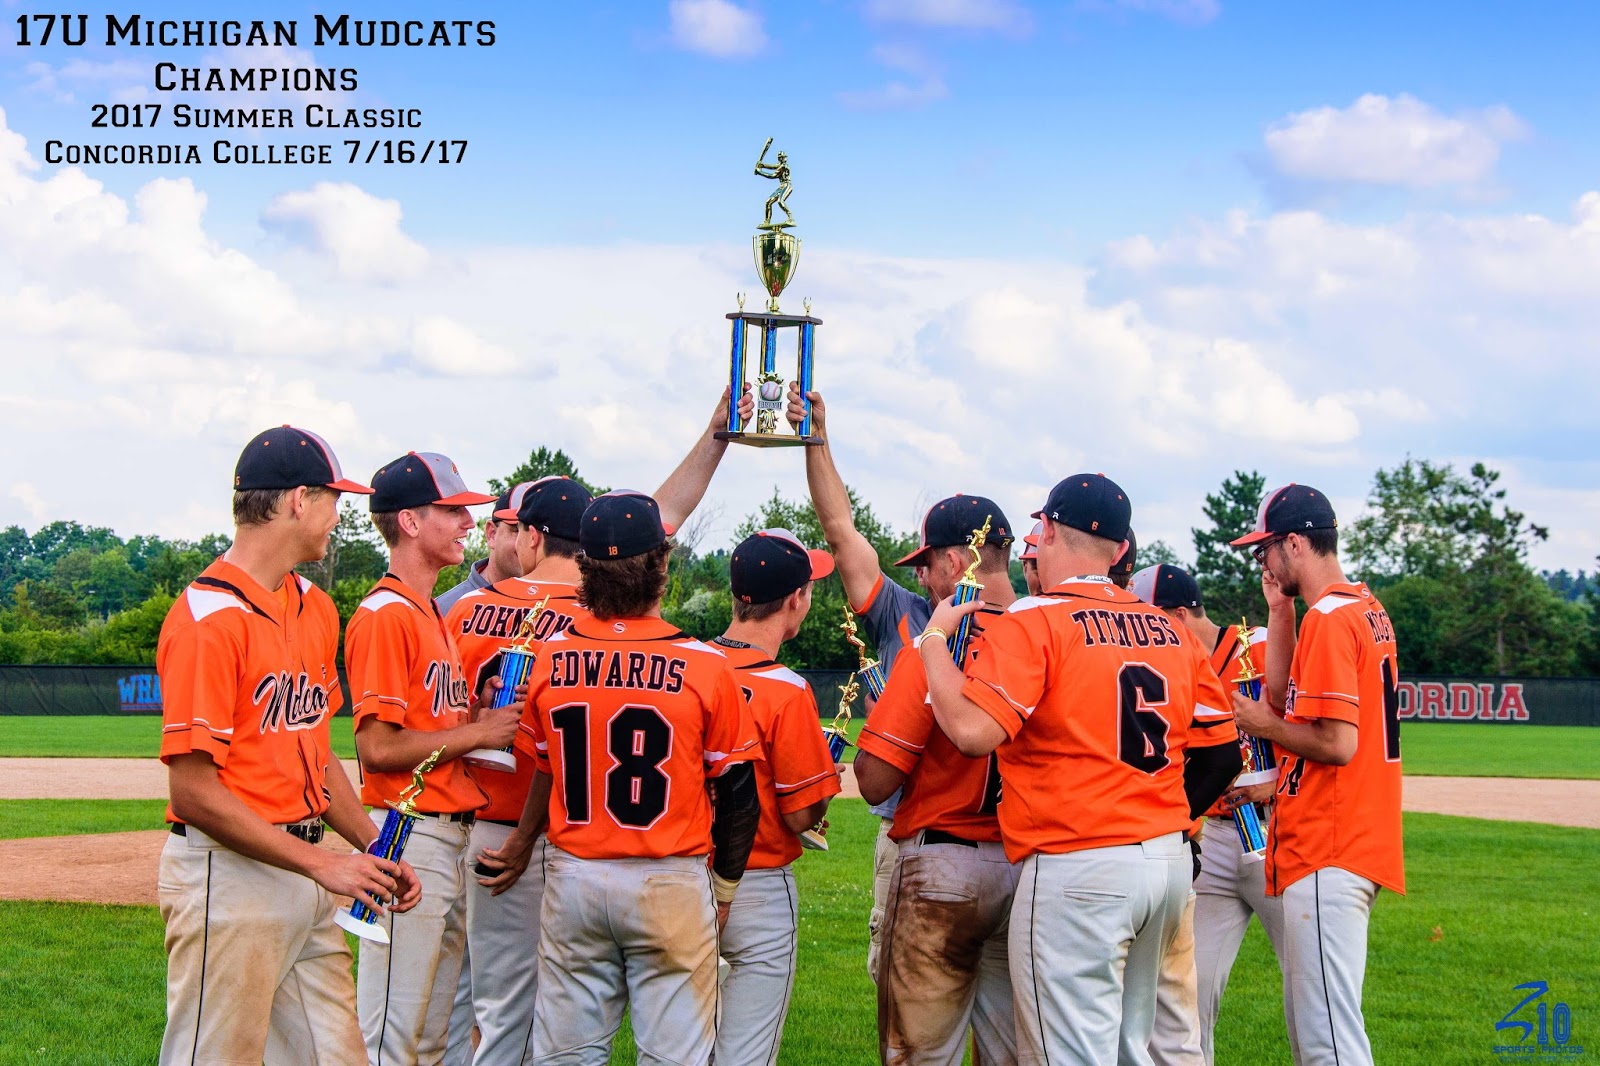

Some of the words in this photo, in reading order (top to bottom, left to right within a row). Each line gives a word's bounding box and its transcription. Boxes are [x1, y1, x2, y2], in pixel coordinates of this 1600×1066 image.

[608, 546, 618, 556] 18
[1071, 608, 1181, 648] TITMUSS
[549, 650, 687, 694] EDWARDS
[1117, 662, 1171, 777] 6
[549, 702, 674, 831] 18
